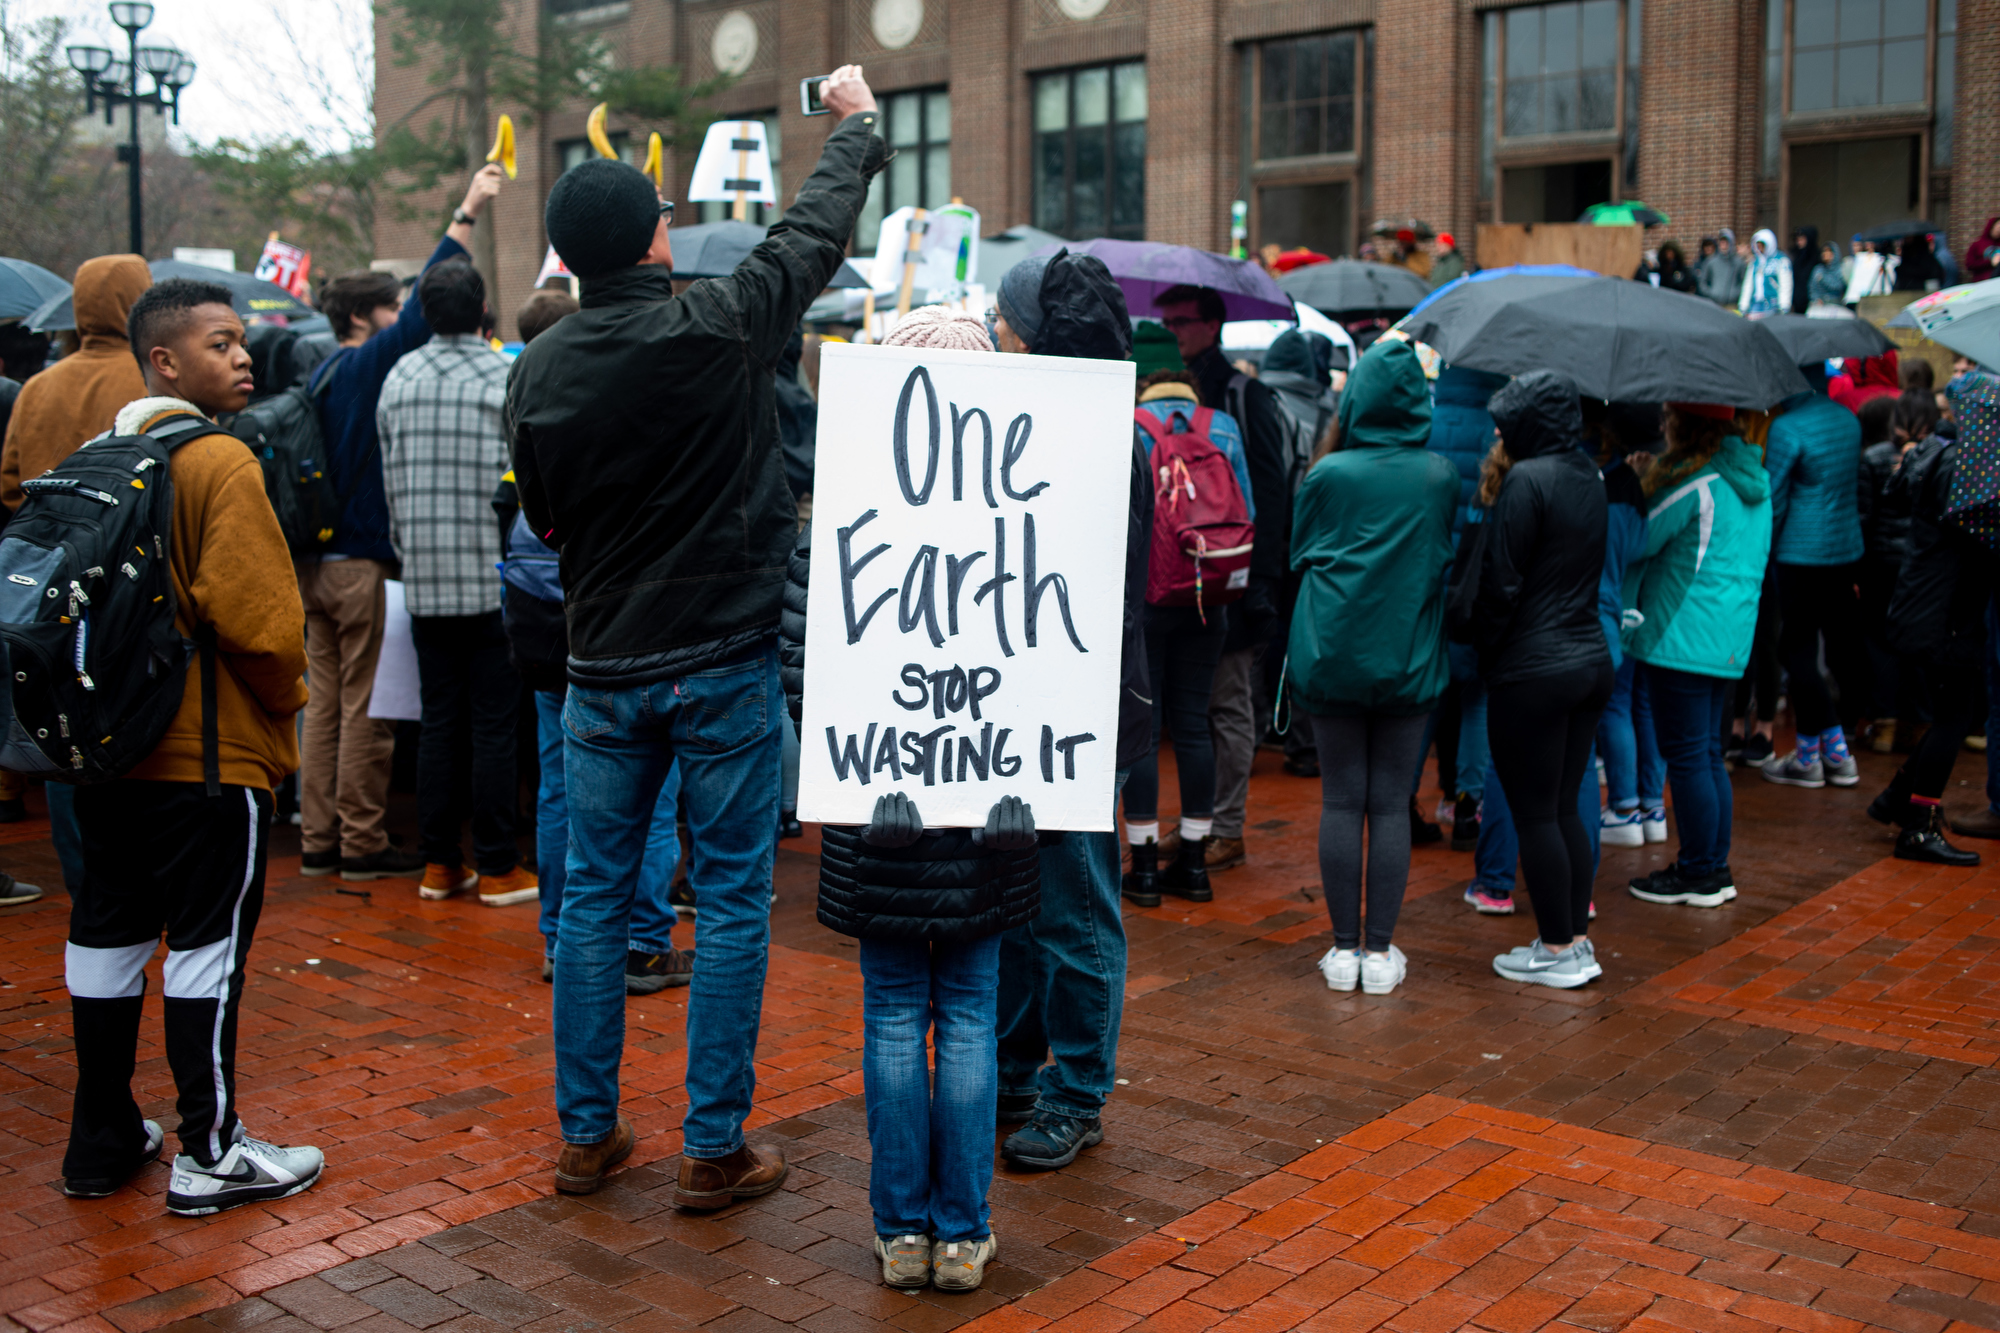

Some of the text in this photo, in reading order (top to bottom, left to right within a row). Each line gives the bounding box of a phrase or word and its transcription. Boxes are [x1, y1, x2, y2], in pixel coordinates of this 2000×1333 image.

[893, 365, 1051, 509] One
[836, 508, 1089, 658] Earth
[892, 662, 1002, 722] STOP
[825, 721, 1097, 787] WASTING IT
